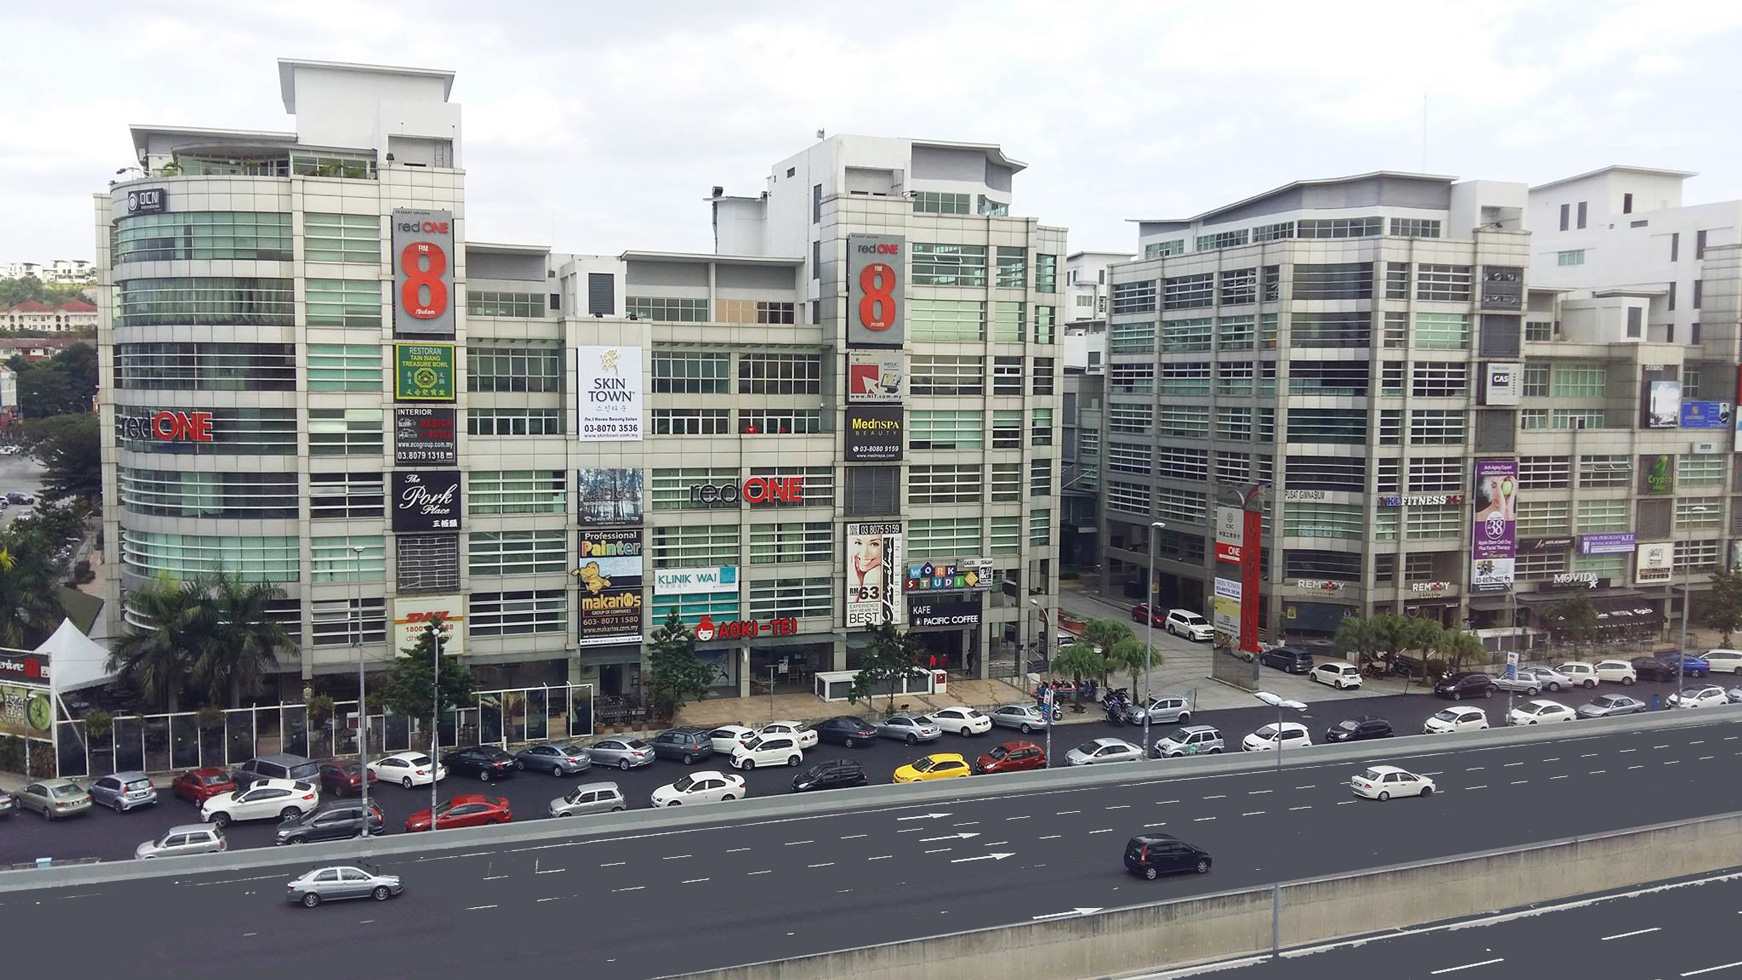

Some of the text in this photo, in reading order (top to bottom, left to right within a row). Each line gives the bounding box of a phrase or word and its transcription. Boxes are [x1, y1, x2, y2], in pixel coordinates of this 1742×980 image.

[139, 192, 159, 205] OCN
[401, 241, 448, 320] 8
[859, 262, 896, 331] 8
[409, 347, 441, 355] RESTORAN
[594, 378, 625, 390] SKIN
[1494, 375, 1509, 383] CAS
[588, 391, 632, 402] TOWN
[584, 424, 638, 432] 03-8070 3536
[397, 452, 426, 460] 03.8079
[404, 474, 421, 483] The
[399, 484, 458, 509] Pork
[420, 504, 450, 515] Place
[860, 524, 900, 535] 03 8075 5159
[1489, 520, 1503, 536] 38
[585, 532, 637, 541] Professional
[581, 540, 641, 557] Painter
[911, 567, 955, 576] WORK
[658, 574, 691, 584] KLINIK
[696, 573, 717, 583] WAI
[1553, 573, 1598, 584] MOVIDA
[858, 586, 880, 600] 63
[913, 606, 931, 614] KAFE
[849, 611, 879, 624] BEST
[923, 615, 979, 626] PACIFIC COFFEE
[718, 617, 798, 639] AOKI-TEI
